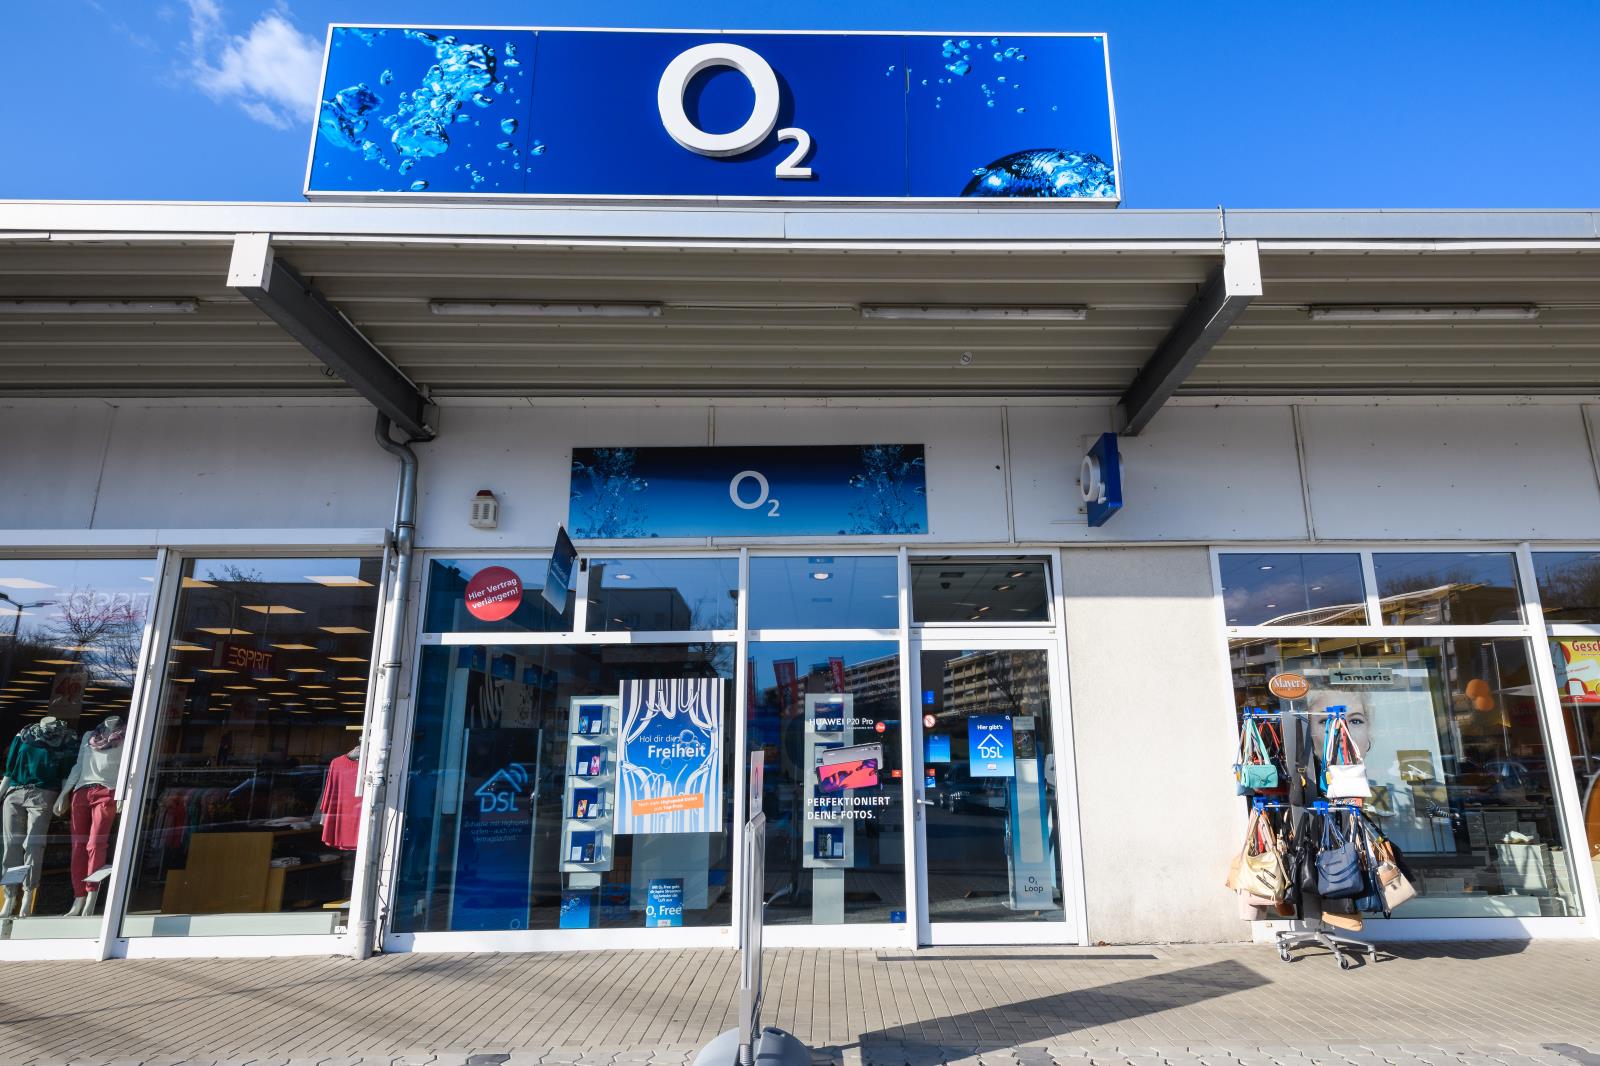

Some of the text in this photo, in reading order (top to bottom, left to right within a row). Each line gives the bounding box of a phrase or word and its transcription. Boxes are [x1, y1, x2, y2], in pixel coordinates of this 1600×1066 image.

[657, 42, 812, 179] O2
[729, 470, 780, 517] O2
[468, 578, 517, 601] Hier Vertrag
[472, 587, 519, 609] verlängern!
[228, 646, 273, 669] ESPRIT
[809, 717, 874, 726] HUAWEI P20 Pro
[639, 735, 652, 743] Hol
[653, 734, 664, 743] dir
[647, 744, 706, 758] Freiheit
[981, 746, 1003, 758] DSL
[480, 791, 519, 812] DSL
[807, 796, 891, 807] PERFEKTIONIERT
[807, 810, 876, 820] DEINE FOTOS.
[1024, 885, 1044, 893] Loop
[646, 905, 682, 918] O2 Free
